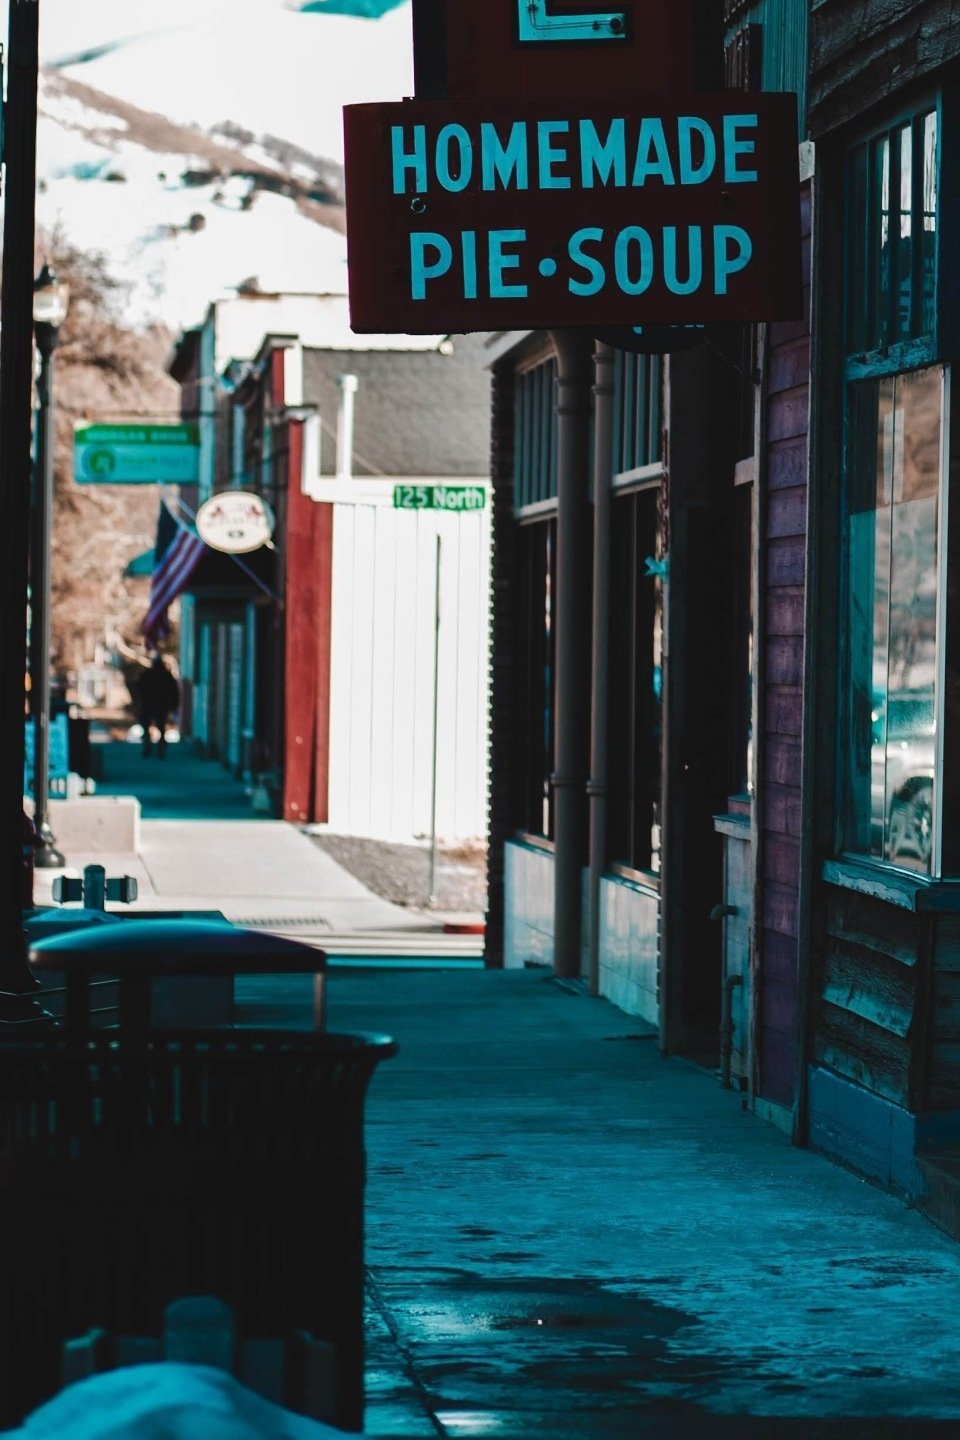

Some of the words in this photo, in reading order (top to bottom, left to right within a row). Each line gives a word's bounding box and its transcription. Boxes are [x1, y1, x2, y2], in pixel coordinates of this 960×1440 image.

[390, 113, 759, 195] HOMEMADE
[395, 486, 430, 508] 125
[432, 486, 484, 509] North
